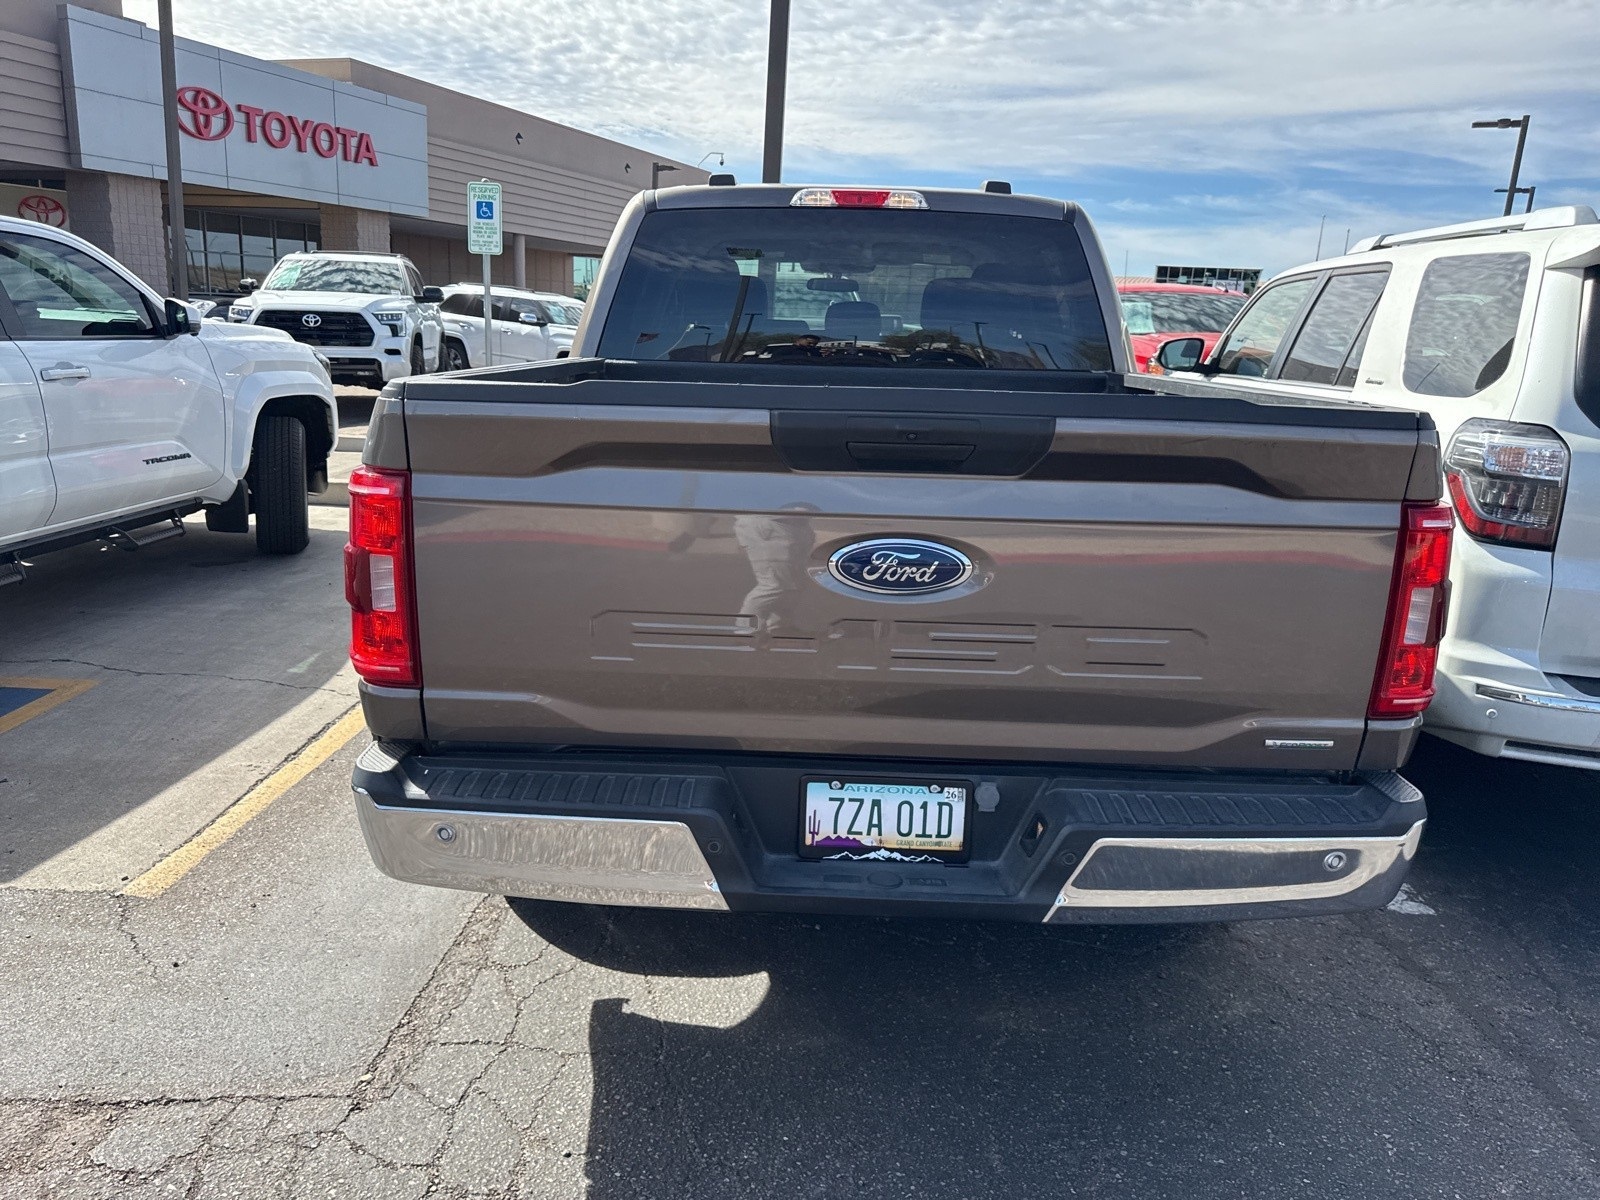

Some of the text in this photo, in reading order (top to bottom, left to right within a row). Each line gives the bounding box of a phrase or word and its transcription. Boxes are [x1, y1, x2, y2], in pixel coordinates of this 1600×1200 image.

[236, 104, 379, 167] TOYOTA
[470, 186, 499, 194] RESERVED
[472, 193, 497, 201] PARKING
[142, 452, 192, 465] TACOMA
[862, 550, 940, 582] Ford
[843, 784, 928, 795] ARIZONA
[945, 790, 957, 799] 26
[828, 797, 954, 839] 7ZA 01D
[896, 839, 914, 847] GRAND
[915, 840, 935, 848] CANYON
